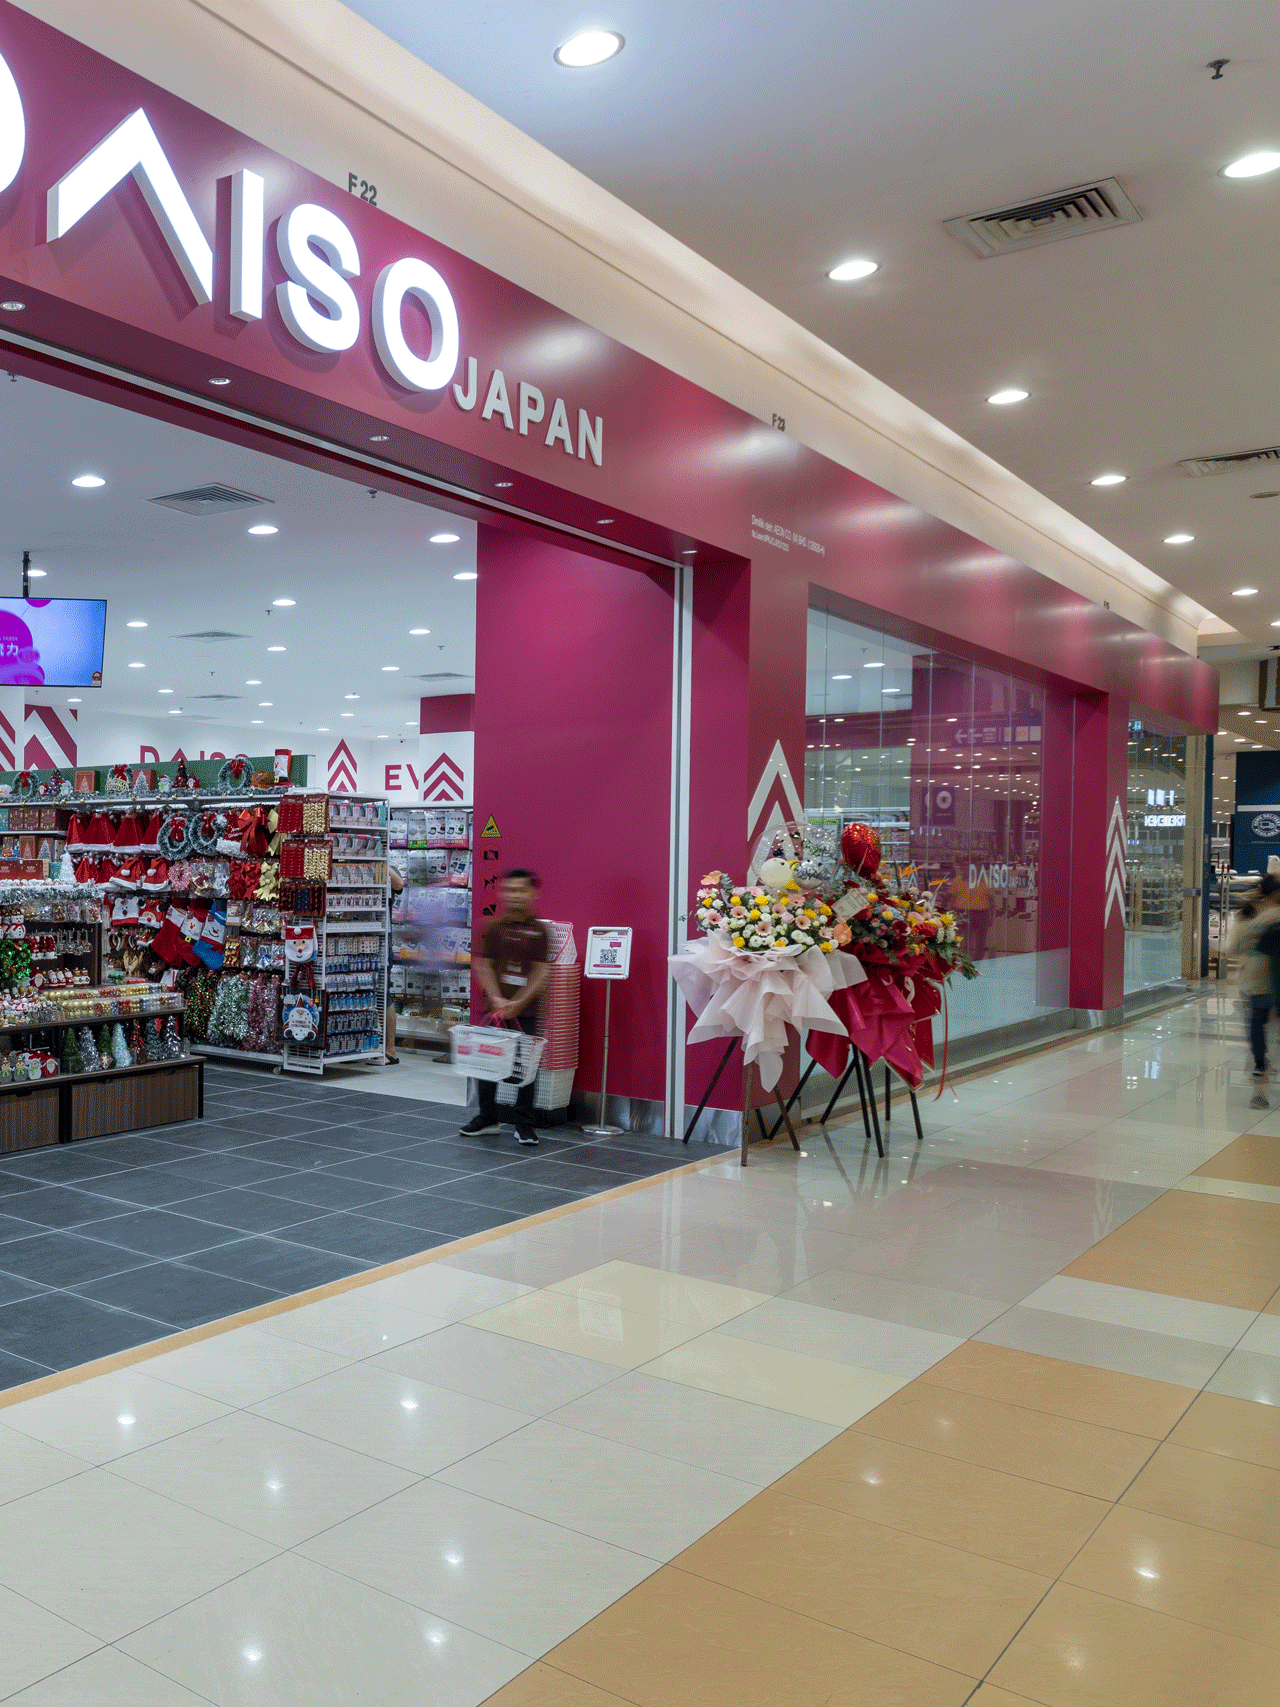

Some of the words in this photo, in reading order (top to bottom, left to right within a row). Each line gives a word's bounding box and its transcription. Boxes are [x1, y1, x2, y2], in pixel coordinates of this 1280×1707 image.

[348, 172, 358, 193] F
[360, 180, 377, 206] 22
[453, 357, 603, 466] JAPAN
[969, 863, 1009, 889] DAISO
